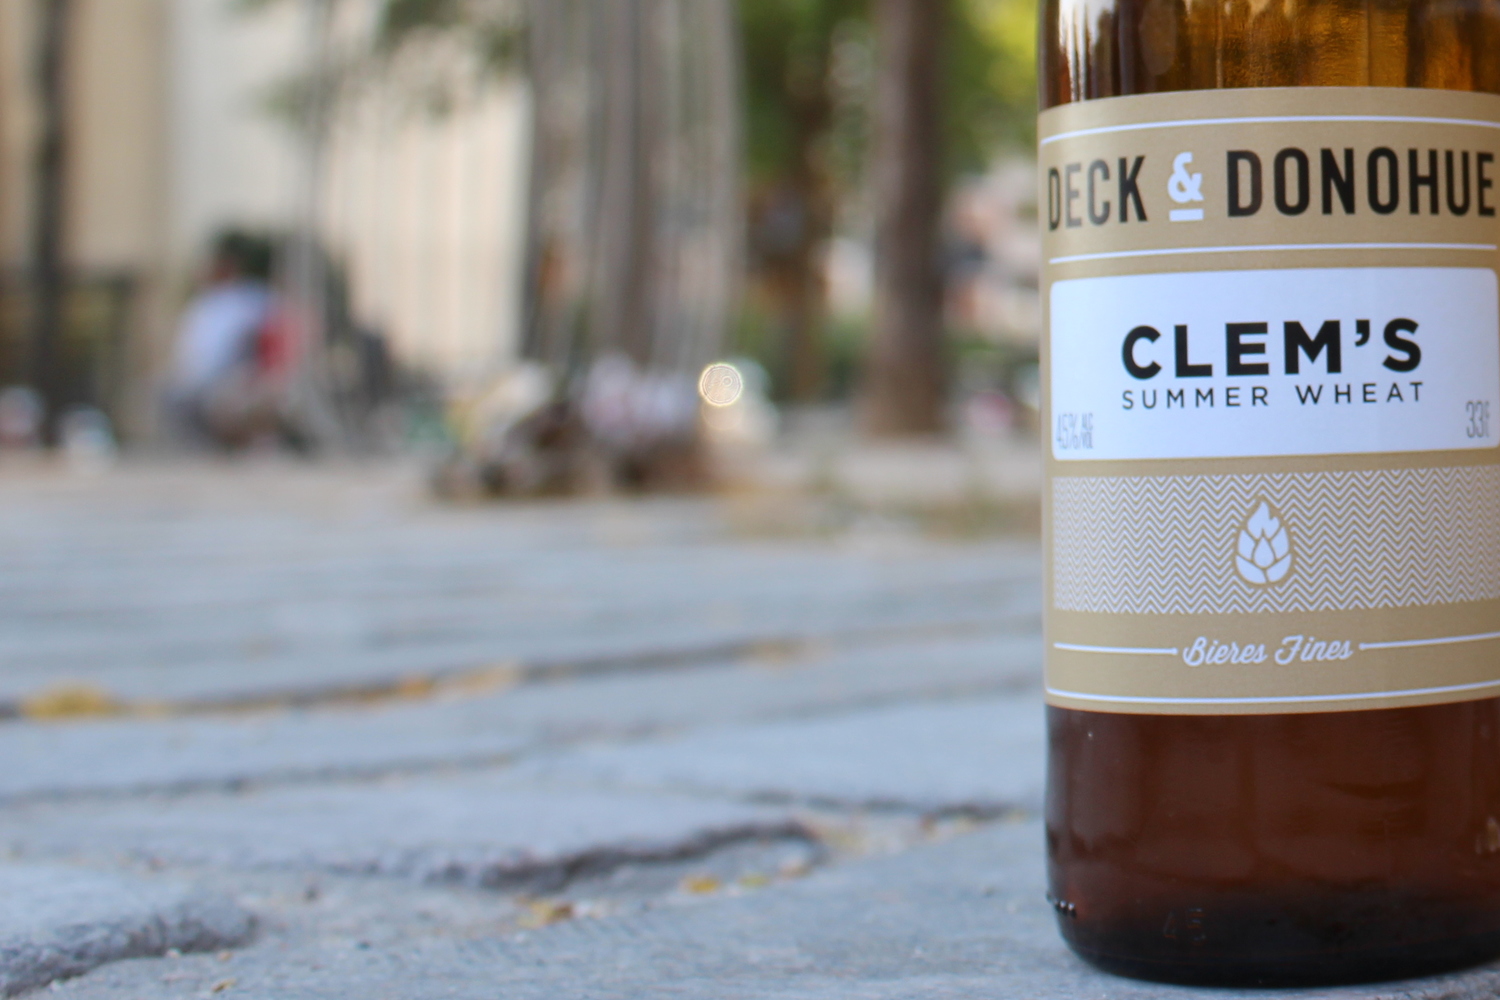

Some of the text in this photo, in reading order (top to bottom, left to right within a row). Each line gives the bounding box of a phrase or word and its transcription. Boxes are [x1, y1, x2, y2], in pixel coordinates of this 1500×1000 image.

[1048, 146, 1497, 232] DECK & DONOHUE
[1121, 317, 1422, 380] CLEM'S
[1121, 382, 1423, 410] SUMMER WHEAT
[1182, 634, 1353, 666] Bieres Fines
